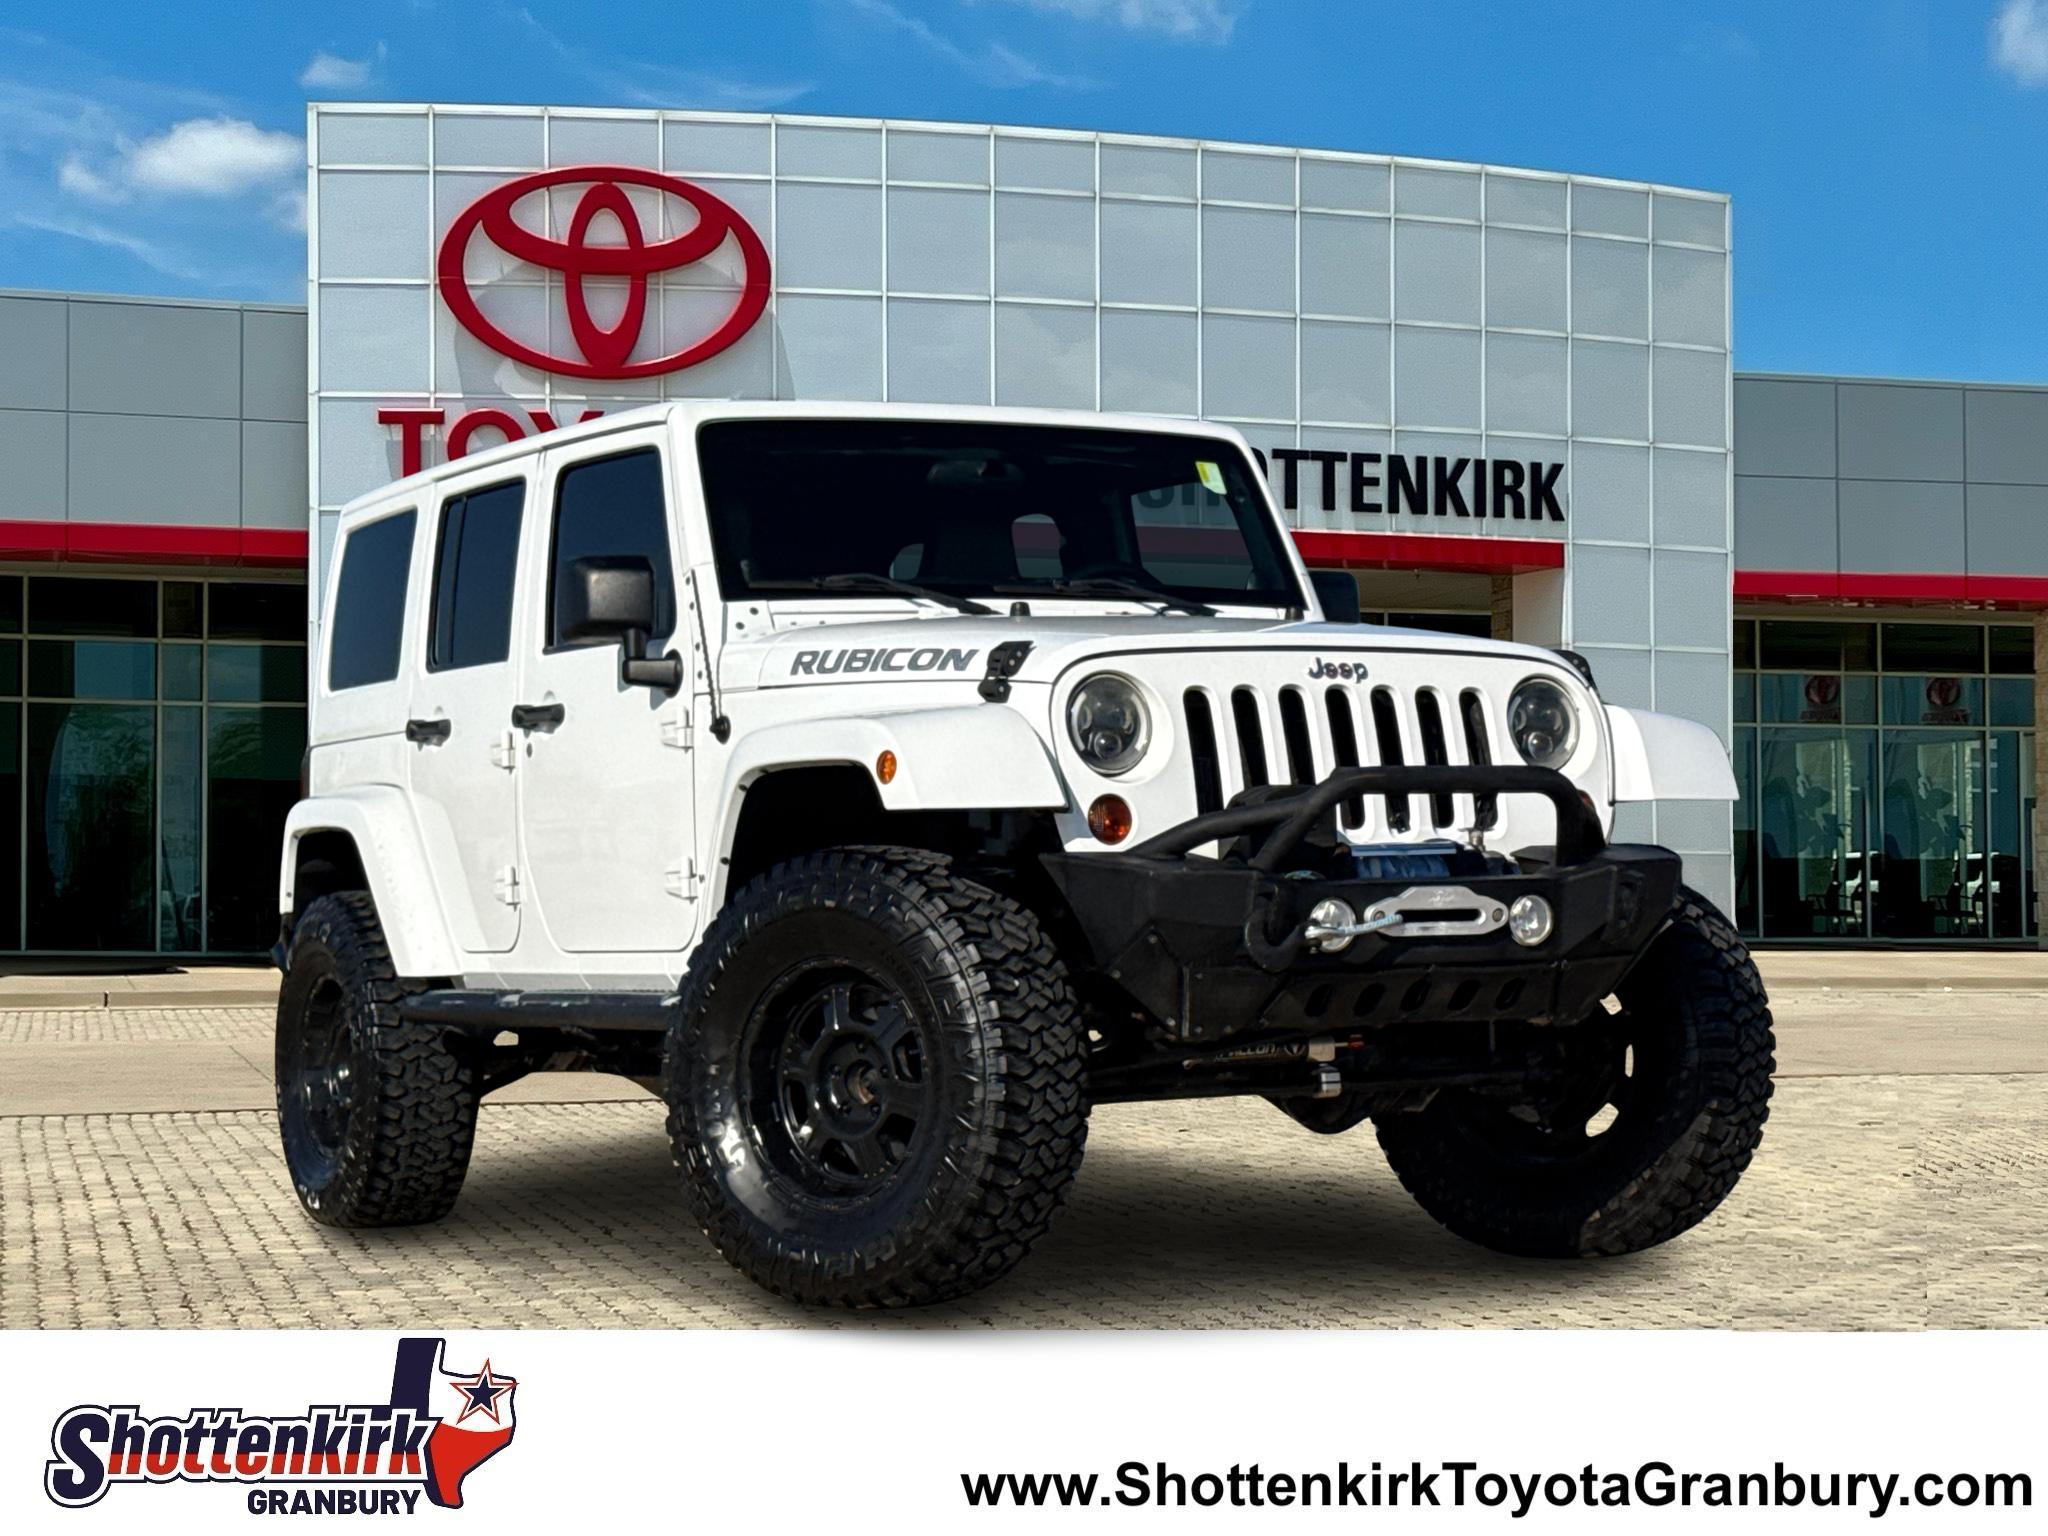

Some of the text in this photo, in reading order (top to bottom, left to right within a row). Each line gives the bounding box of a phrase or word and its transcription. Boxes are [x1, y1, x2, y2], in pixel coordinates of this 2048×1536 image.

[377, 406, 605, 478] TO
[1138, 447, 1565, 522] TTENKIRK
[790, 648, 979, 676] RUBICON
[1308, 656, 1369, 684] Jeep
